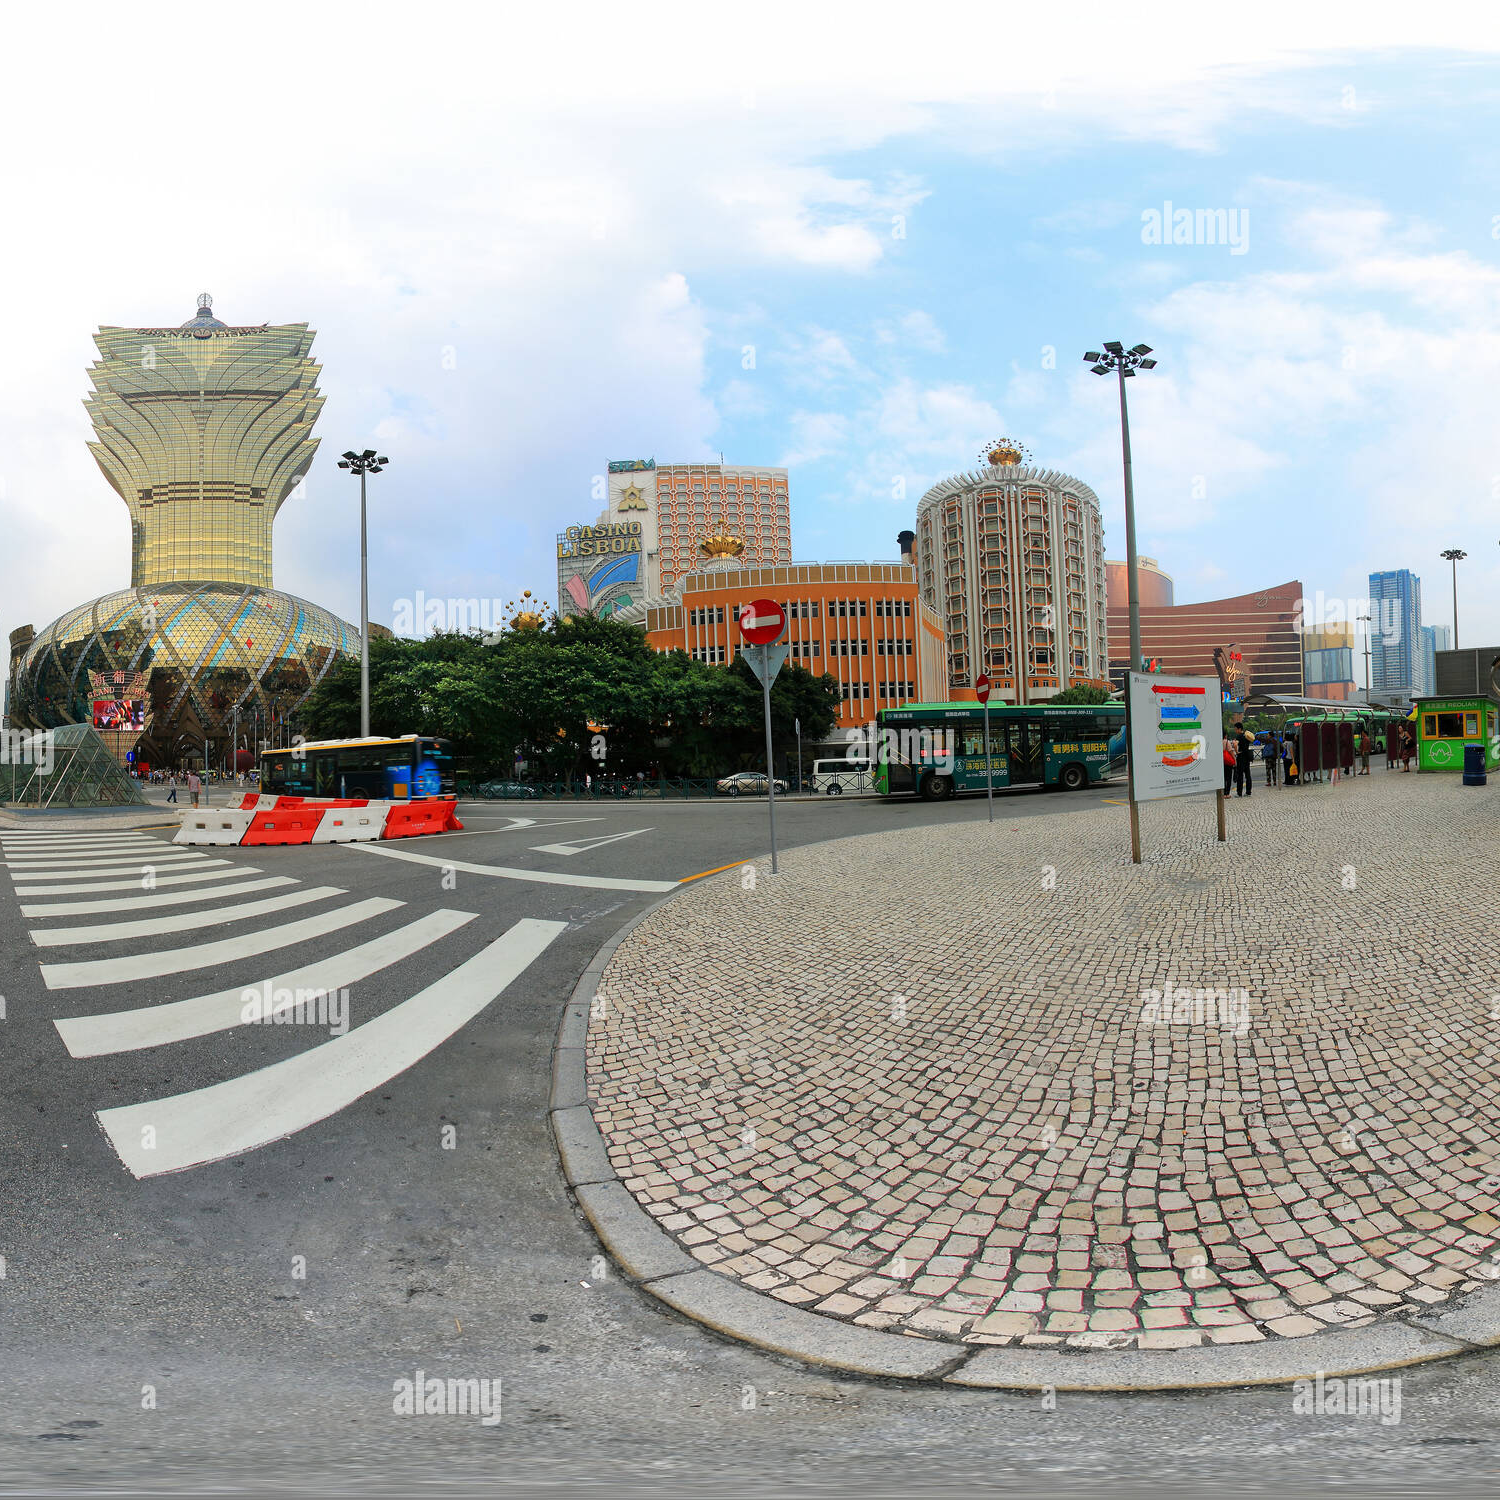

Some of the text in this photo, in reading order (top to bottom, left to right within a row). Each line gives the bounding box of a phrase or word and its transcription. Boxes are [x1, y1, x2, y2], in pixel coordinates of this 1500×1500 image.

[609, 459, 656, 473] STEAM
[566, 521, 642, 541] CASINO
[557, 537, 642, 559] LISBOA
[88, 687, 115, 698] GRAND
